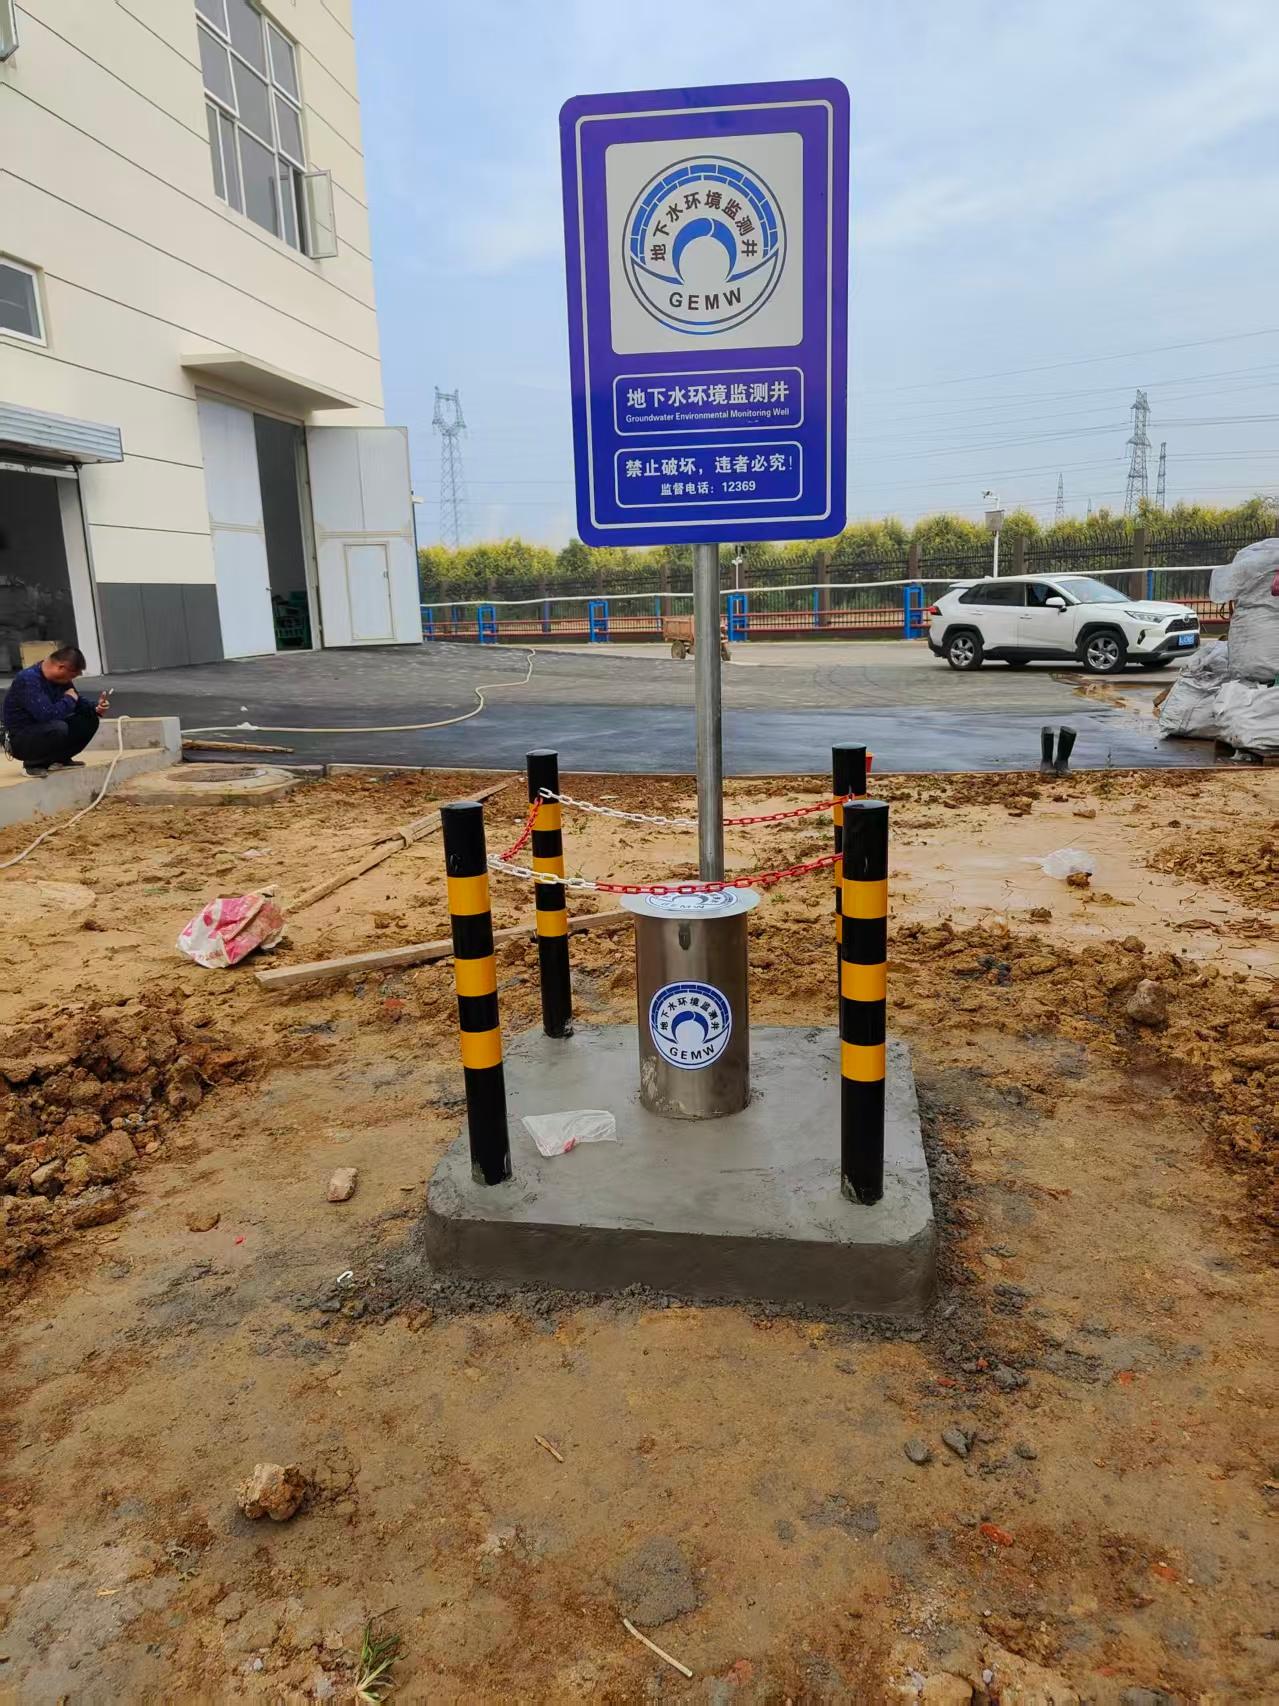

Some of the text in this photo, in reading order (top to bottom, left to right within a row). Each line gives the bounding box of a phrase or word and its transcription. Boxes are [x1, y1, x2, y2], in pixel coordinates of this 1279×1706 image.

[650, 190, 758, 262] 地下水环境监测井
[669, 287, 742, 311] GEMW
[626, 381, 789, 408] 地下水环境监测井
[625, 407, 790, 424] Groundwater Environmental Monitoring Well
[721, 480, 756, 493] 12369
[660, 996, 720, 1031] 地下水环境监测井
[669, 1044, 716, 1061] GEMW
